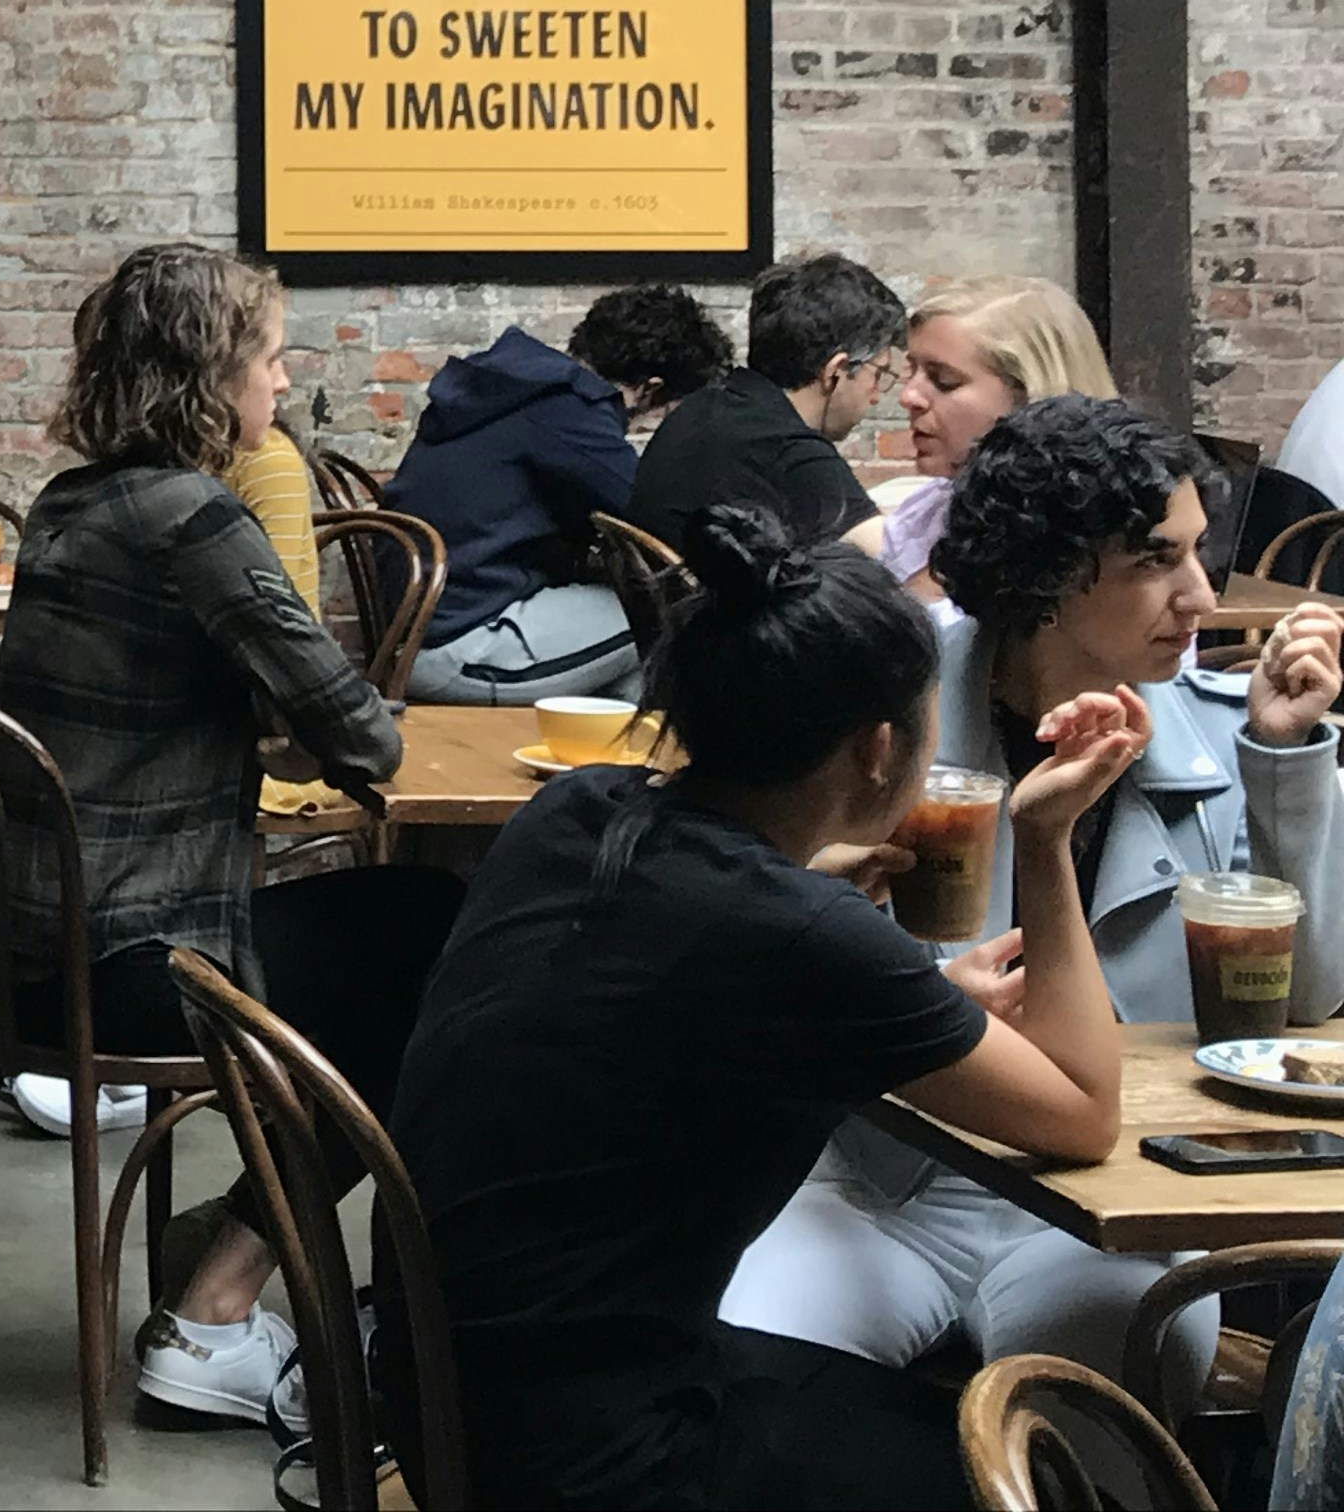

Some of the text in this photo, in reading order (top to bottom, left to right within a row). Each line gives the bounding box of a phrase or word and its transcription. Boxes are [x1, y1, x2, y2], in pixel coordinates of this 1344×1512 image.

[359, 10, 648, 59] TO SWEETEN
[293, 82, 716, 131] MY IMAGINATION.
[352, 193, 435, 210] William
[446, 193, 577, 212] Shakespeare
